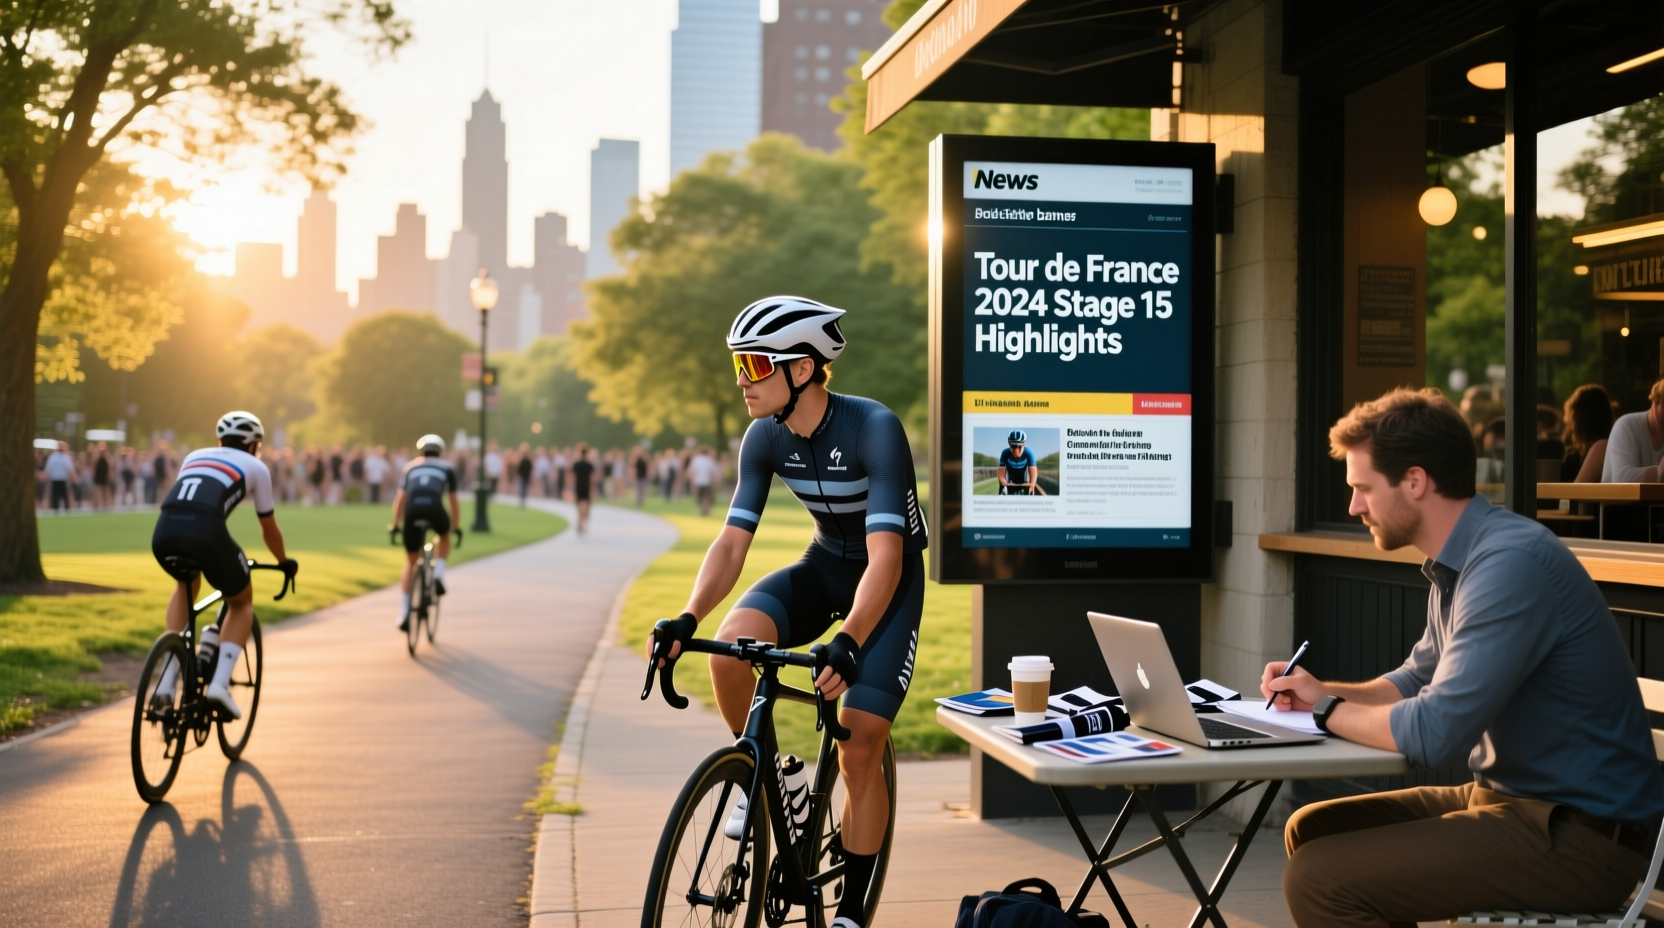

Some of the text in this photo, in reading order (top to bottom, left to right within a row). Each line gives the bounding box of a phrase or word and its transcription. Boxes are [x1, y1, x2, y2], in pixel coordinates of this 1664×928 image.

[974, 170, 1039, 190] News
[974, 252, 1180, 284] Tour de France
[974, 287, 1173, 325] 2024 Stage 15
[975, 322, 1123, 361] Highlights
